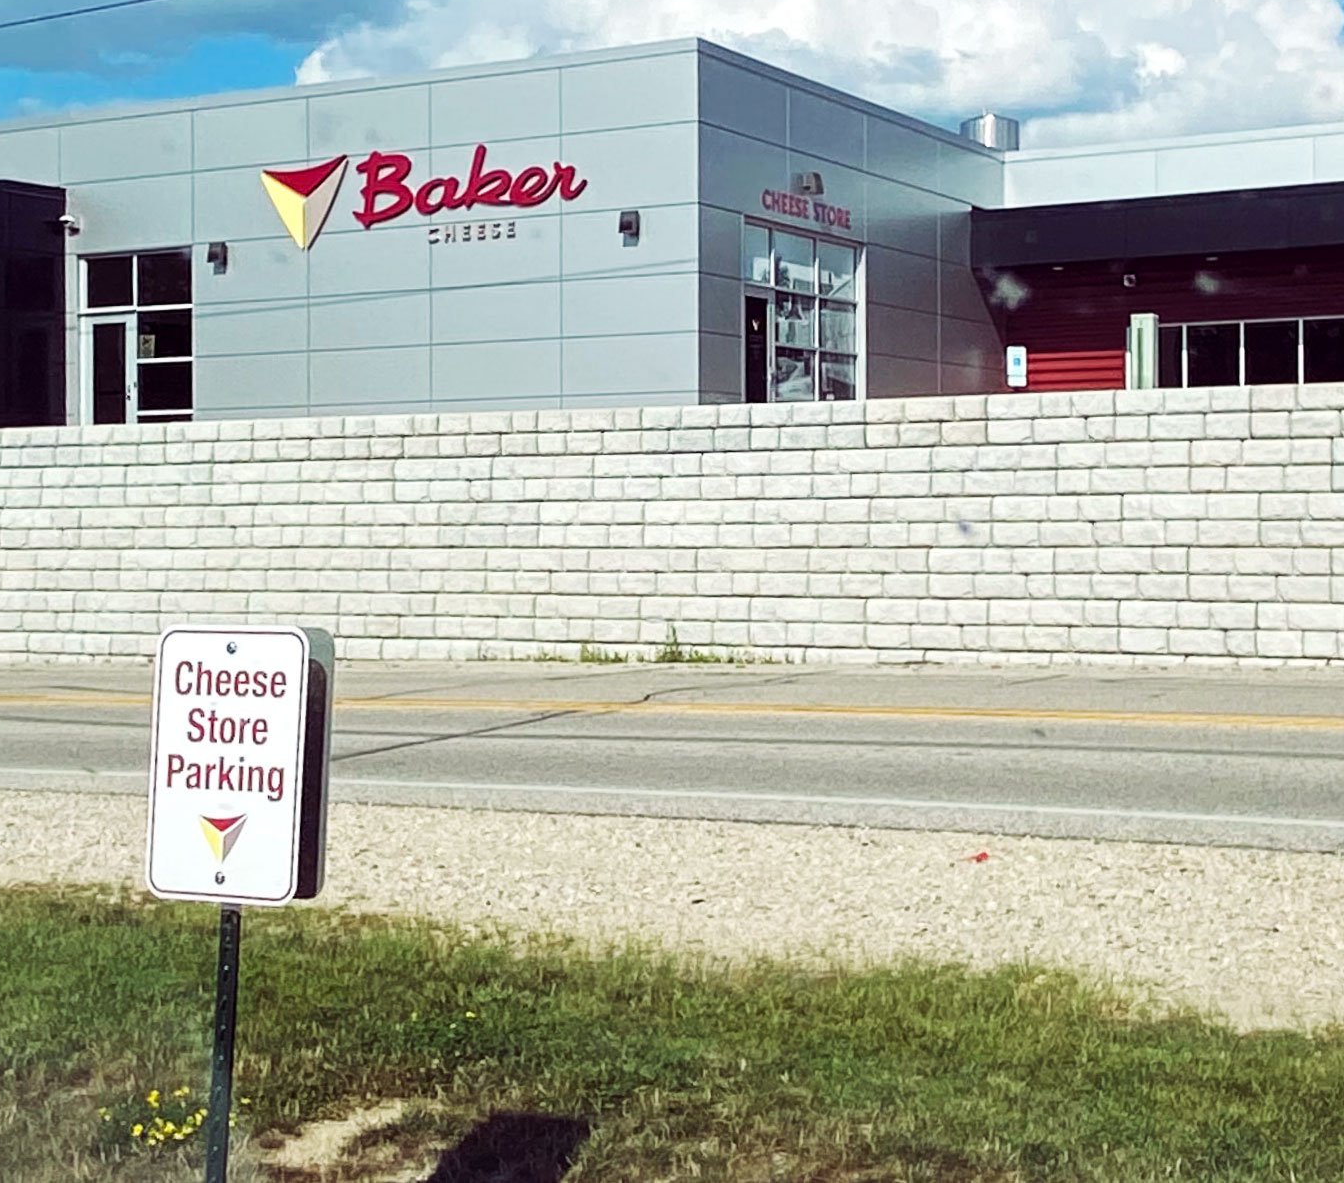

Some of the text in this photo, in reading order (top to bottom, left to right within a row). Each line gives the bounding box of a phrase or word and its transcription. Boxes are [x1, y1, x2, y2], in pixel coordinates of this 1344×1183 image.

[352, 143, 588, 230] Baker
[761, 189, 852, 230] CHEESE STORE
[428, 221, 516, 245] CHEESE
[175, 660, 287, 699] Cheese
[186, 707, 268, 745] Store
[166, 753, 285, 802] Parking
